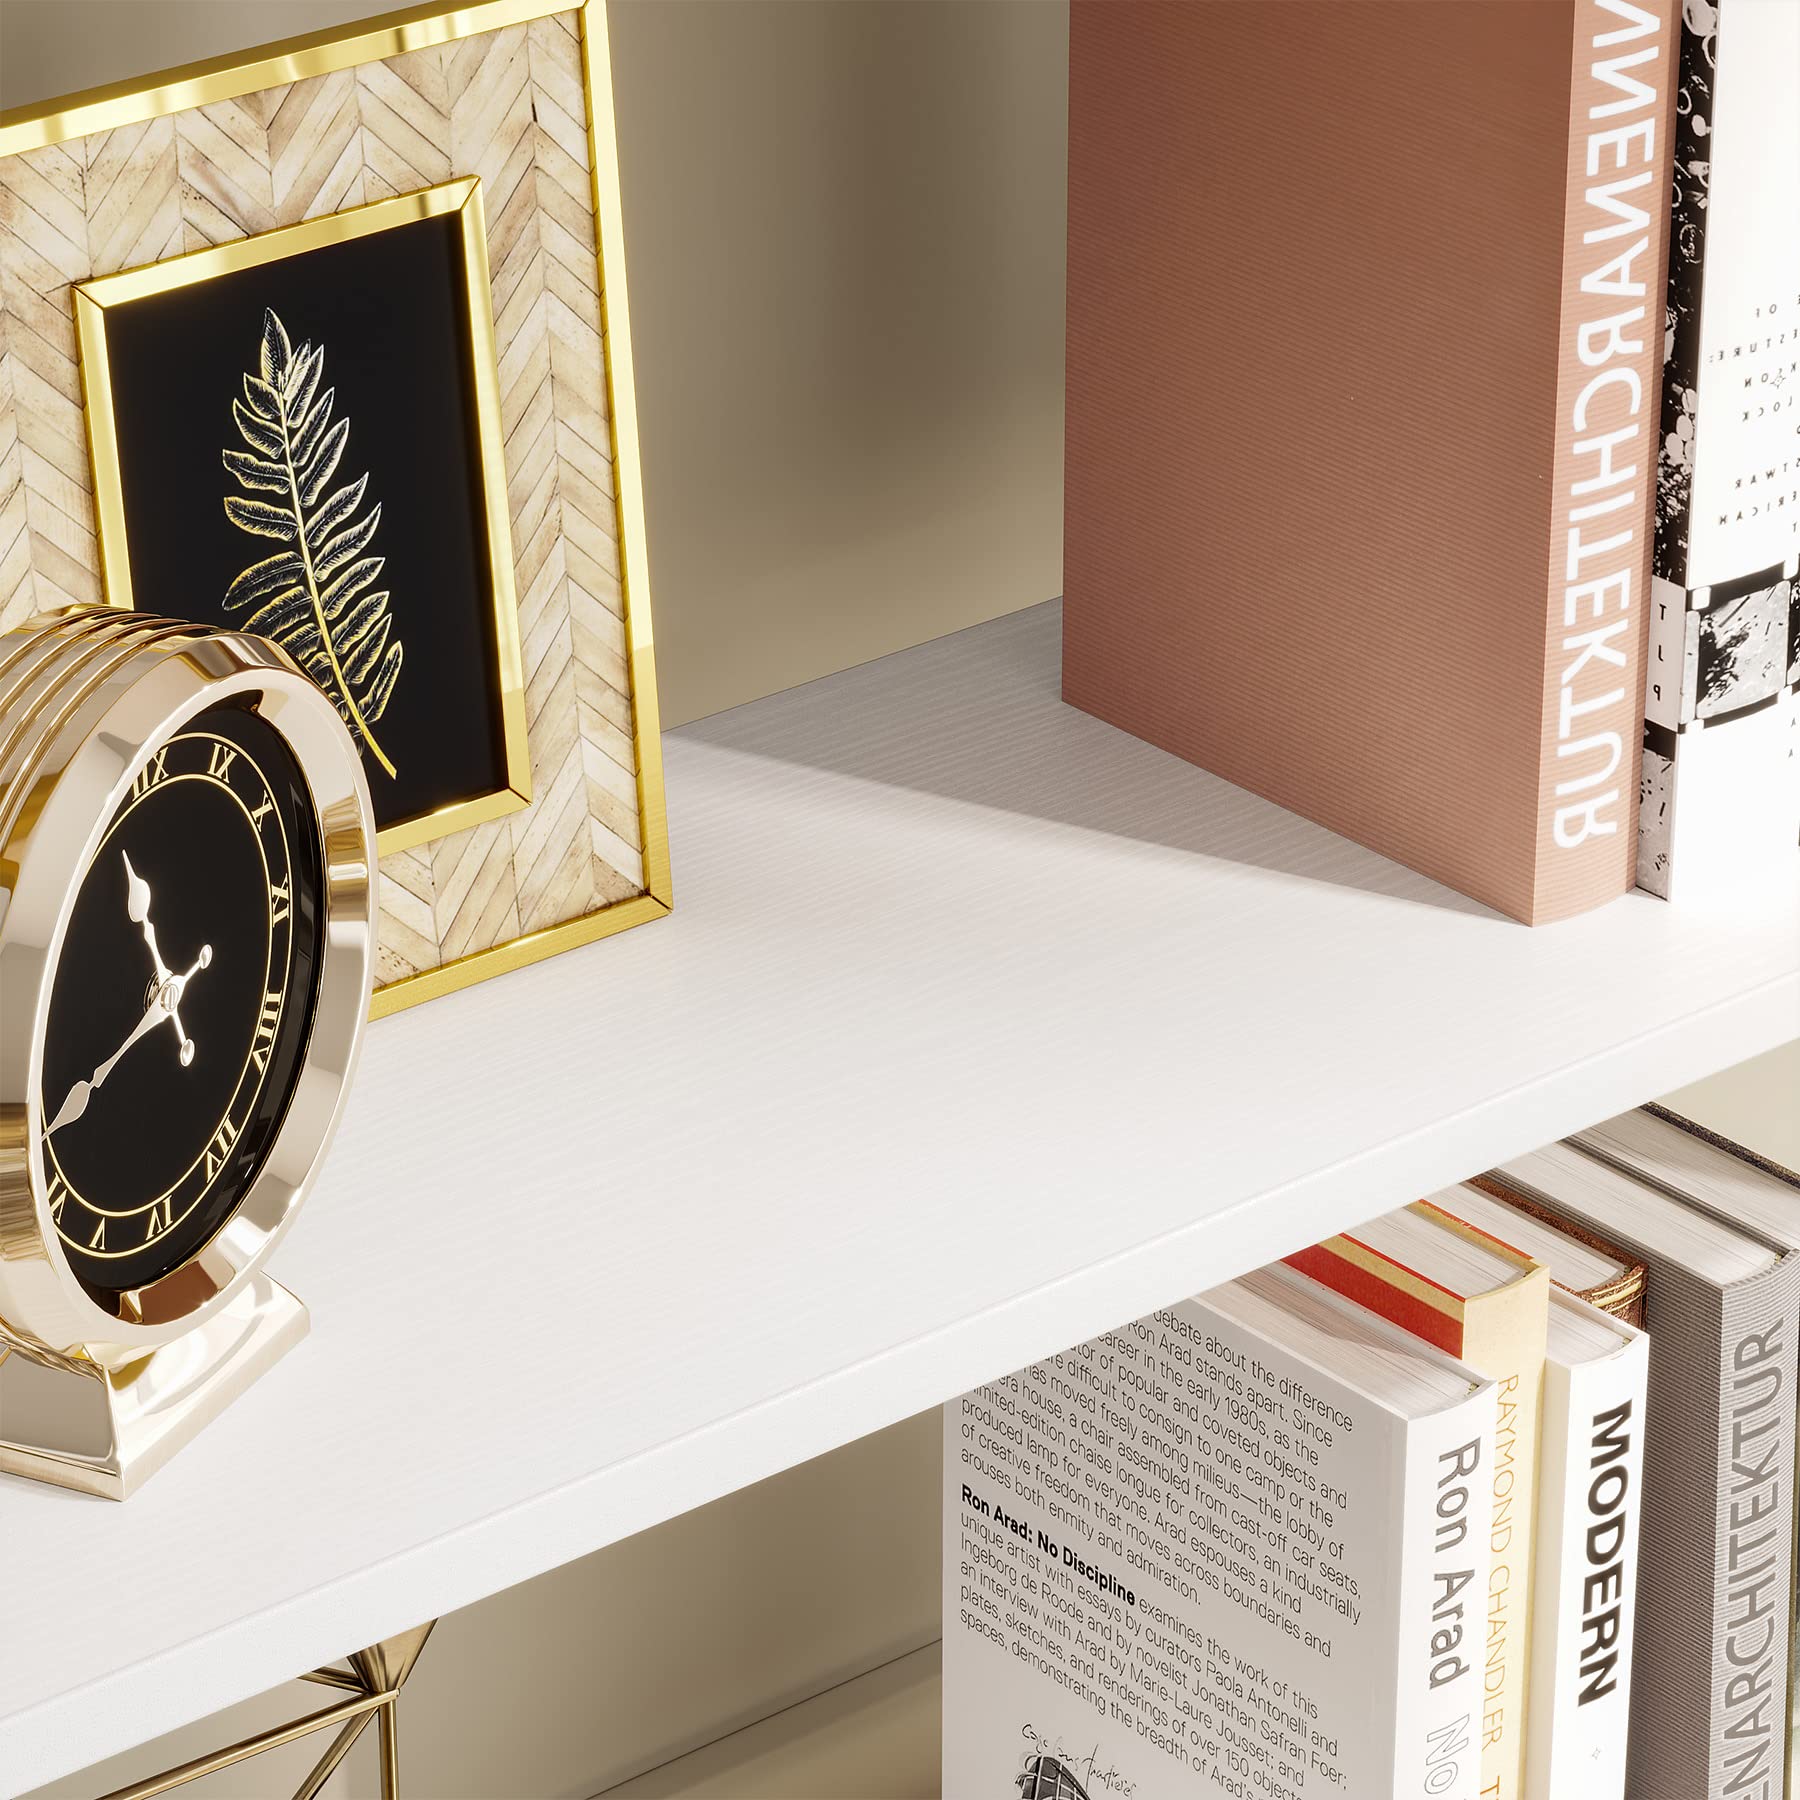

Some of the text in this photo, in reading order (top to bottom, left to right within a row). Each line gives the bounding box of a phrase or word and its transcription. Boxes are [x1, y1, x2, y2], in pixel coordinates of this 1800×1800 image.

[1024, 1366, 1047, 1385] as
[1051, 1376, 1096, 1415] moved
[1101, 1403, 1138, 1441] freely
[1142, 1431, 1189, 1474] among
[1287, 1511, 1325, 1552] lobby
[1329, 1542, 1345, 1561] of
[1068, 1359, 1118, 1402] difficult
[1122, 1390, 1136, 1412] to
[1139, 1404, 1193, 1446] consign
[1197, 1435, 1212, 1457] to
[1216, 1449, 1242, 1474] one
[1246, 1467, 1286, 1502] camp
[1290, 1492, 1305, 1510] or
[1310, 1501, 1334, 1528] the
[1100, 1355, 1115, 1374] of
[1119, 1365, 1170, 1405] popular
[1173, 1397, 1199, 1424] and
[1203, 1415, 1260, 1460] coveted
[1264, 1450, 1316, 1492] objects
[1321, 1483, 1347, 1511] and
[1144, 1349, 1156, 1373] in
[1160, 1361, 1183, 1388] the
[1187, 1379, 1221, 1412] early
[1225, 1397, 1269, 1440] 1980s,
[1274, 1430, 1291, 1450] as
[1295, 1439, 1319, 1466] the
[1159, 1333, 1192, 1367] Arad
[1196, 1358, 1243, 1396] stands
[1247, 1387, 1288, 1423] apart.
[1293, 1409, 1333, 1448] Since
[1206, 1337, 1247, 1373] about
[1251, 1360, 1276, 1388] the
[1279, 1378, 1353, 1433] difference
[1491, 1374, 1519, 1553] RAYMOND
[960, 1449, 1201, 1606] arouses both enmity and admiration.
[961, 1399, 1302, 1614] produced lamp for everyone. Arad espouses a kind
[961, 1424, 1331, 1658] of creative freedom that moves across boundaries and
[1023, 1380, 1066, 1424] house,
[1070, 1413, 1078, 1429] a
[1081, 1420, 1115, 1449] chair
[1118, 1442, 1190, 1497] assembled
[1195, 1484, 1228, 1519] from
[1232, 1510, 1288, 1553] cast-off
[1293, 1546, 1316, 1569] car
[1320, 1562, 1361, 1600] seats,
[1070, 1438, 1113, 1475] chaise
[1117, 1461, 1161, 1504] longue
[1166, 1493, 1185, 1517] for
[1189, 1511, 1259, 1565] collectors,
[1264, 1555, 1281, 1577] an
[1286, 1563, 1361, 1626] industrially
[1434, 1436, 1481, 1554] Ron
[1578, 1398, 1633, 1708] MODERN
[960, 1561, 977, 1582] an
[981, 1569, 1039, 1620] interview
[1043, 1612, 1071, 1641] with
[1075, 1630, 1106, 1662] Arad
[1111, 1650, 1126, 1677] by
[1131, 1663, 1213, 1730] Marie-Laure
[1279, 1762, 1305, 1787] and
[960, 1585, 1002, 1623] plates,
[1006, 1613, 1066, 1664] sketches,
[1070, 1655, 1095, 1680] and
[1099, 1673, 1169, 1727] renderings
[1172, 1720, 1187, 1737] of
[1191, 1731, 1221, 1759] over
[1225, 1749, 1250, 1778] 150
[960, 1609, 1008, 1651] spaces,
[1012, 1640, 1106, 1716] demonstrating
[1111, 1702, 1133, 1728] the
[1137, 1716, 1188, 1764] breadth
[1193, 1757, 1207, 1775] of
[961, 1483, 1318, 1720] Ron Arad: No Discipline examines the work of this
[961, 1513, 1338, 1757] unique artist with essays by curators Paola Antonelli and
[961, 1532, 1017, 1587] Ingeborg
[1021, 1573, 1038, 1595] de
[1042, 1582, 1084, 1624] Roode
[1088, 1616, 1112, 1642] and
[1117, 1629, 1133, 1656] by
[1137, 1647, 1188, 1690] novelist
[1192, 1680, 1256, 1733] Jonathan
[1261, 1720, 1307, 1764] Safran
[1429, 1568, 1476, 1692] Arad
[1482, 1565, 1511, 1752] CHANDLER
